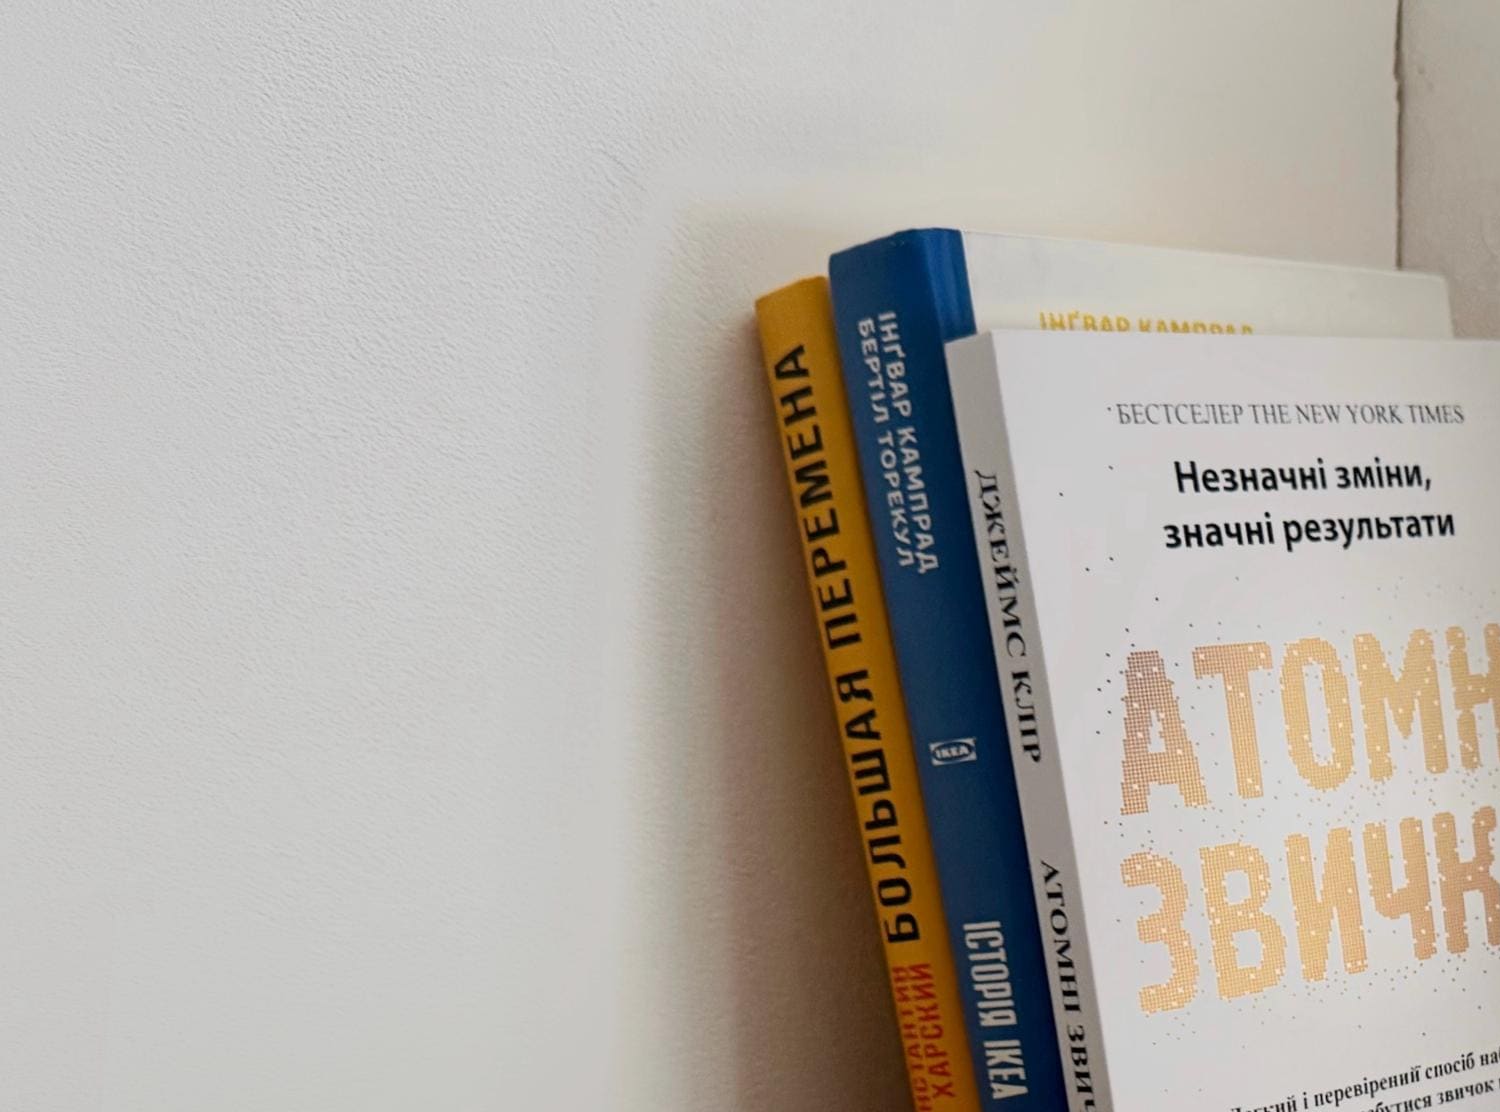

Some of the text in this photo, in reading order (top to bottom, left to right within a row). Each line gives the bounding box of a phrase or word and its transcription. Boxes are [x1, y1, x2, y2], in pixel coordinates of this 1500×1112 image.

[857, 317, 915, 567] БЕРТІЛ ТОРЕКУЛ
[878, 311, 939, 574] ІНҐВАР КАМПРАД
[1116, 403, 1466, 425] БЕСТСЕЛЕР THE NEW YORK TIMES
[1173, 456, 1432, 494] Незначні зміни,
[1162, 511, 1456, 552] значні результати
[774, 343, 921, 944] БОЛЬШАЯ ПЕРЕМЕНА
[973, 469, 1042, 764] ДЖЕЙМС КЛІР
[962, 920, 1018, 1028] ІСТОРІЯ
[1039, 859, 1081, 1014] АТОМНІ
[1302, 1091, 1310, 1111] і
[1313, 1064, 1422, 1108] перевірений
[1425, 1052, 1476, 1082] спосіб
[1436, 1079, 1495, 1106] звичок
